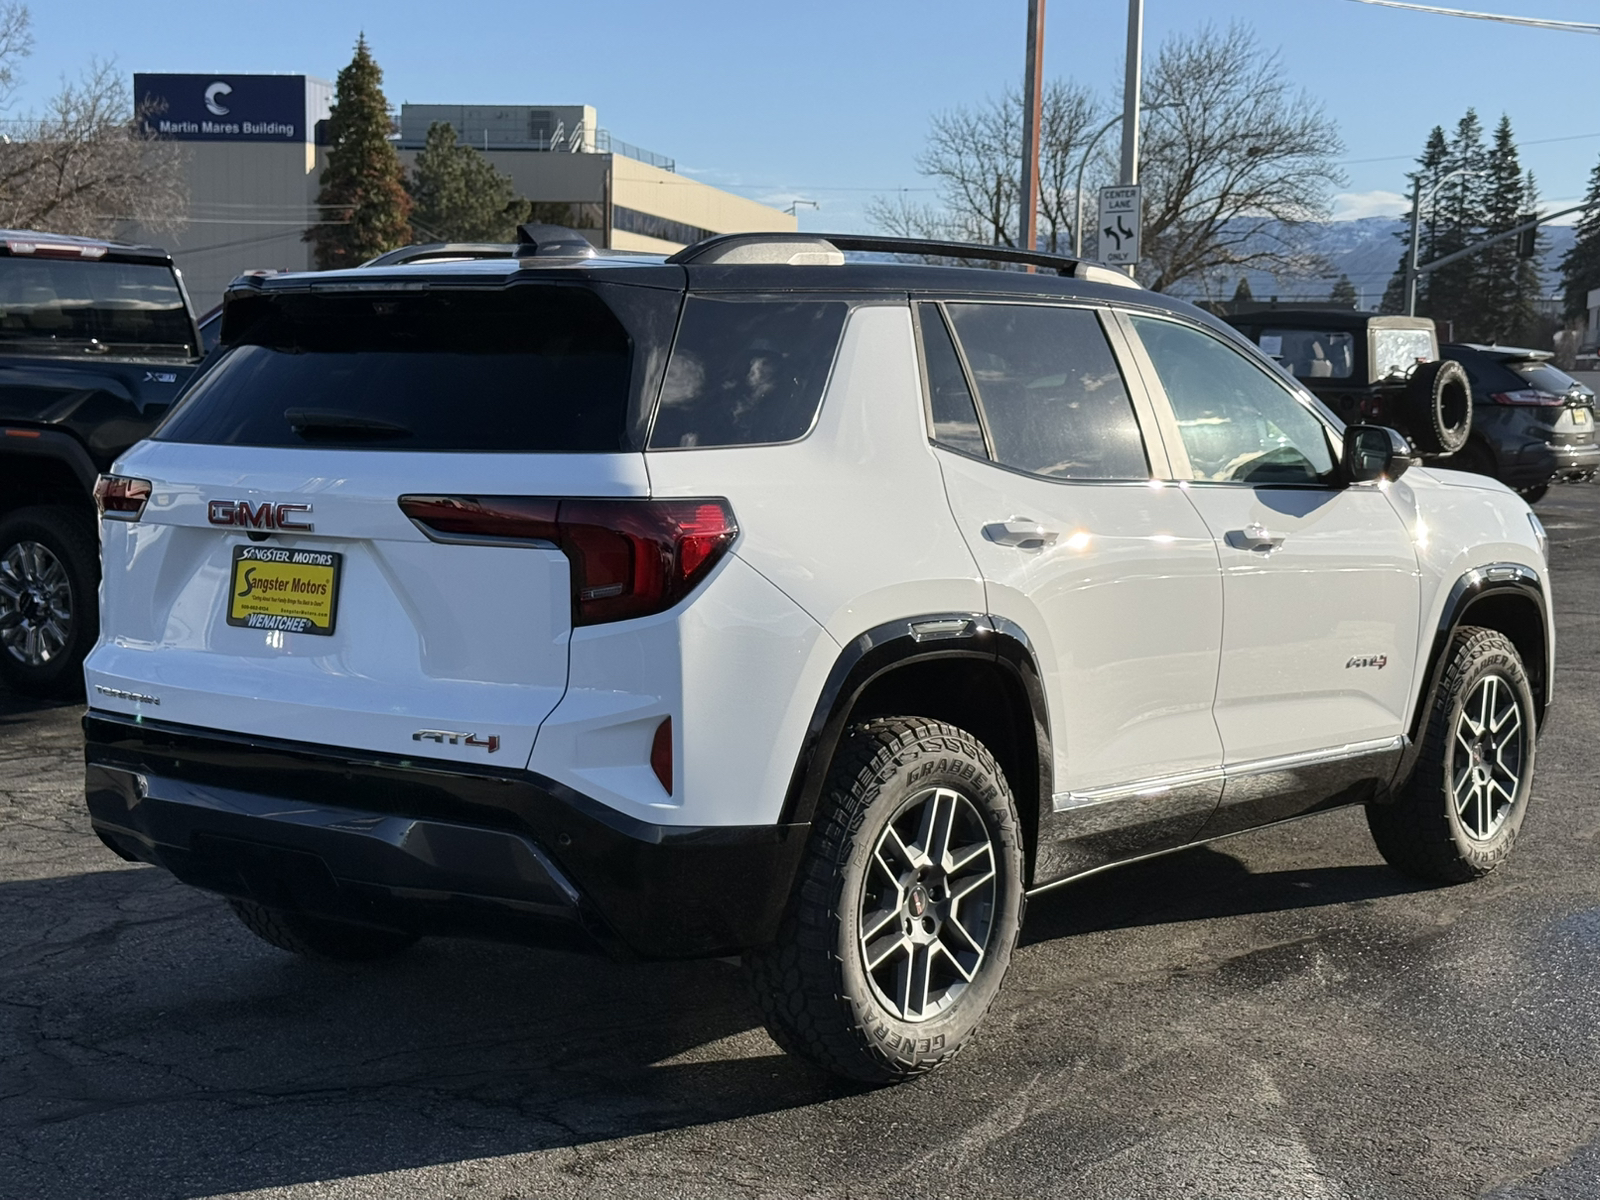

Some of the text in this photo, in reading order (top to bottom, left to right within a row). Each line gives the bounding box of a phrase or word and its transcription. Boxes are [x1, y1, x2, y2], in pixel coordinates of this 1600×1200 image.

[160, 120, 198, 133] Martin
[202, 121, 240, 134] Mares
[243, 121, 294, 137] Building
[1104, 189, 1136, 199] CENTER
[1109, 200, 1131, 209] LANE
[1107, 253, 1129, 261] ONLY
[207, 500, 314, 532] GMC
[237, 546, 333, 565] SANGSTER MOTORS
[237, 566, 327, 597] Sangster Motors
[248, 613, 307, 632] WENATCHEE
[412, 728, 500, 753] AT4
[906, 758, 999, 804] GRABBER
